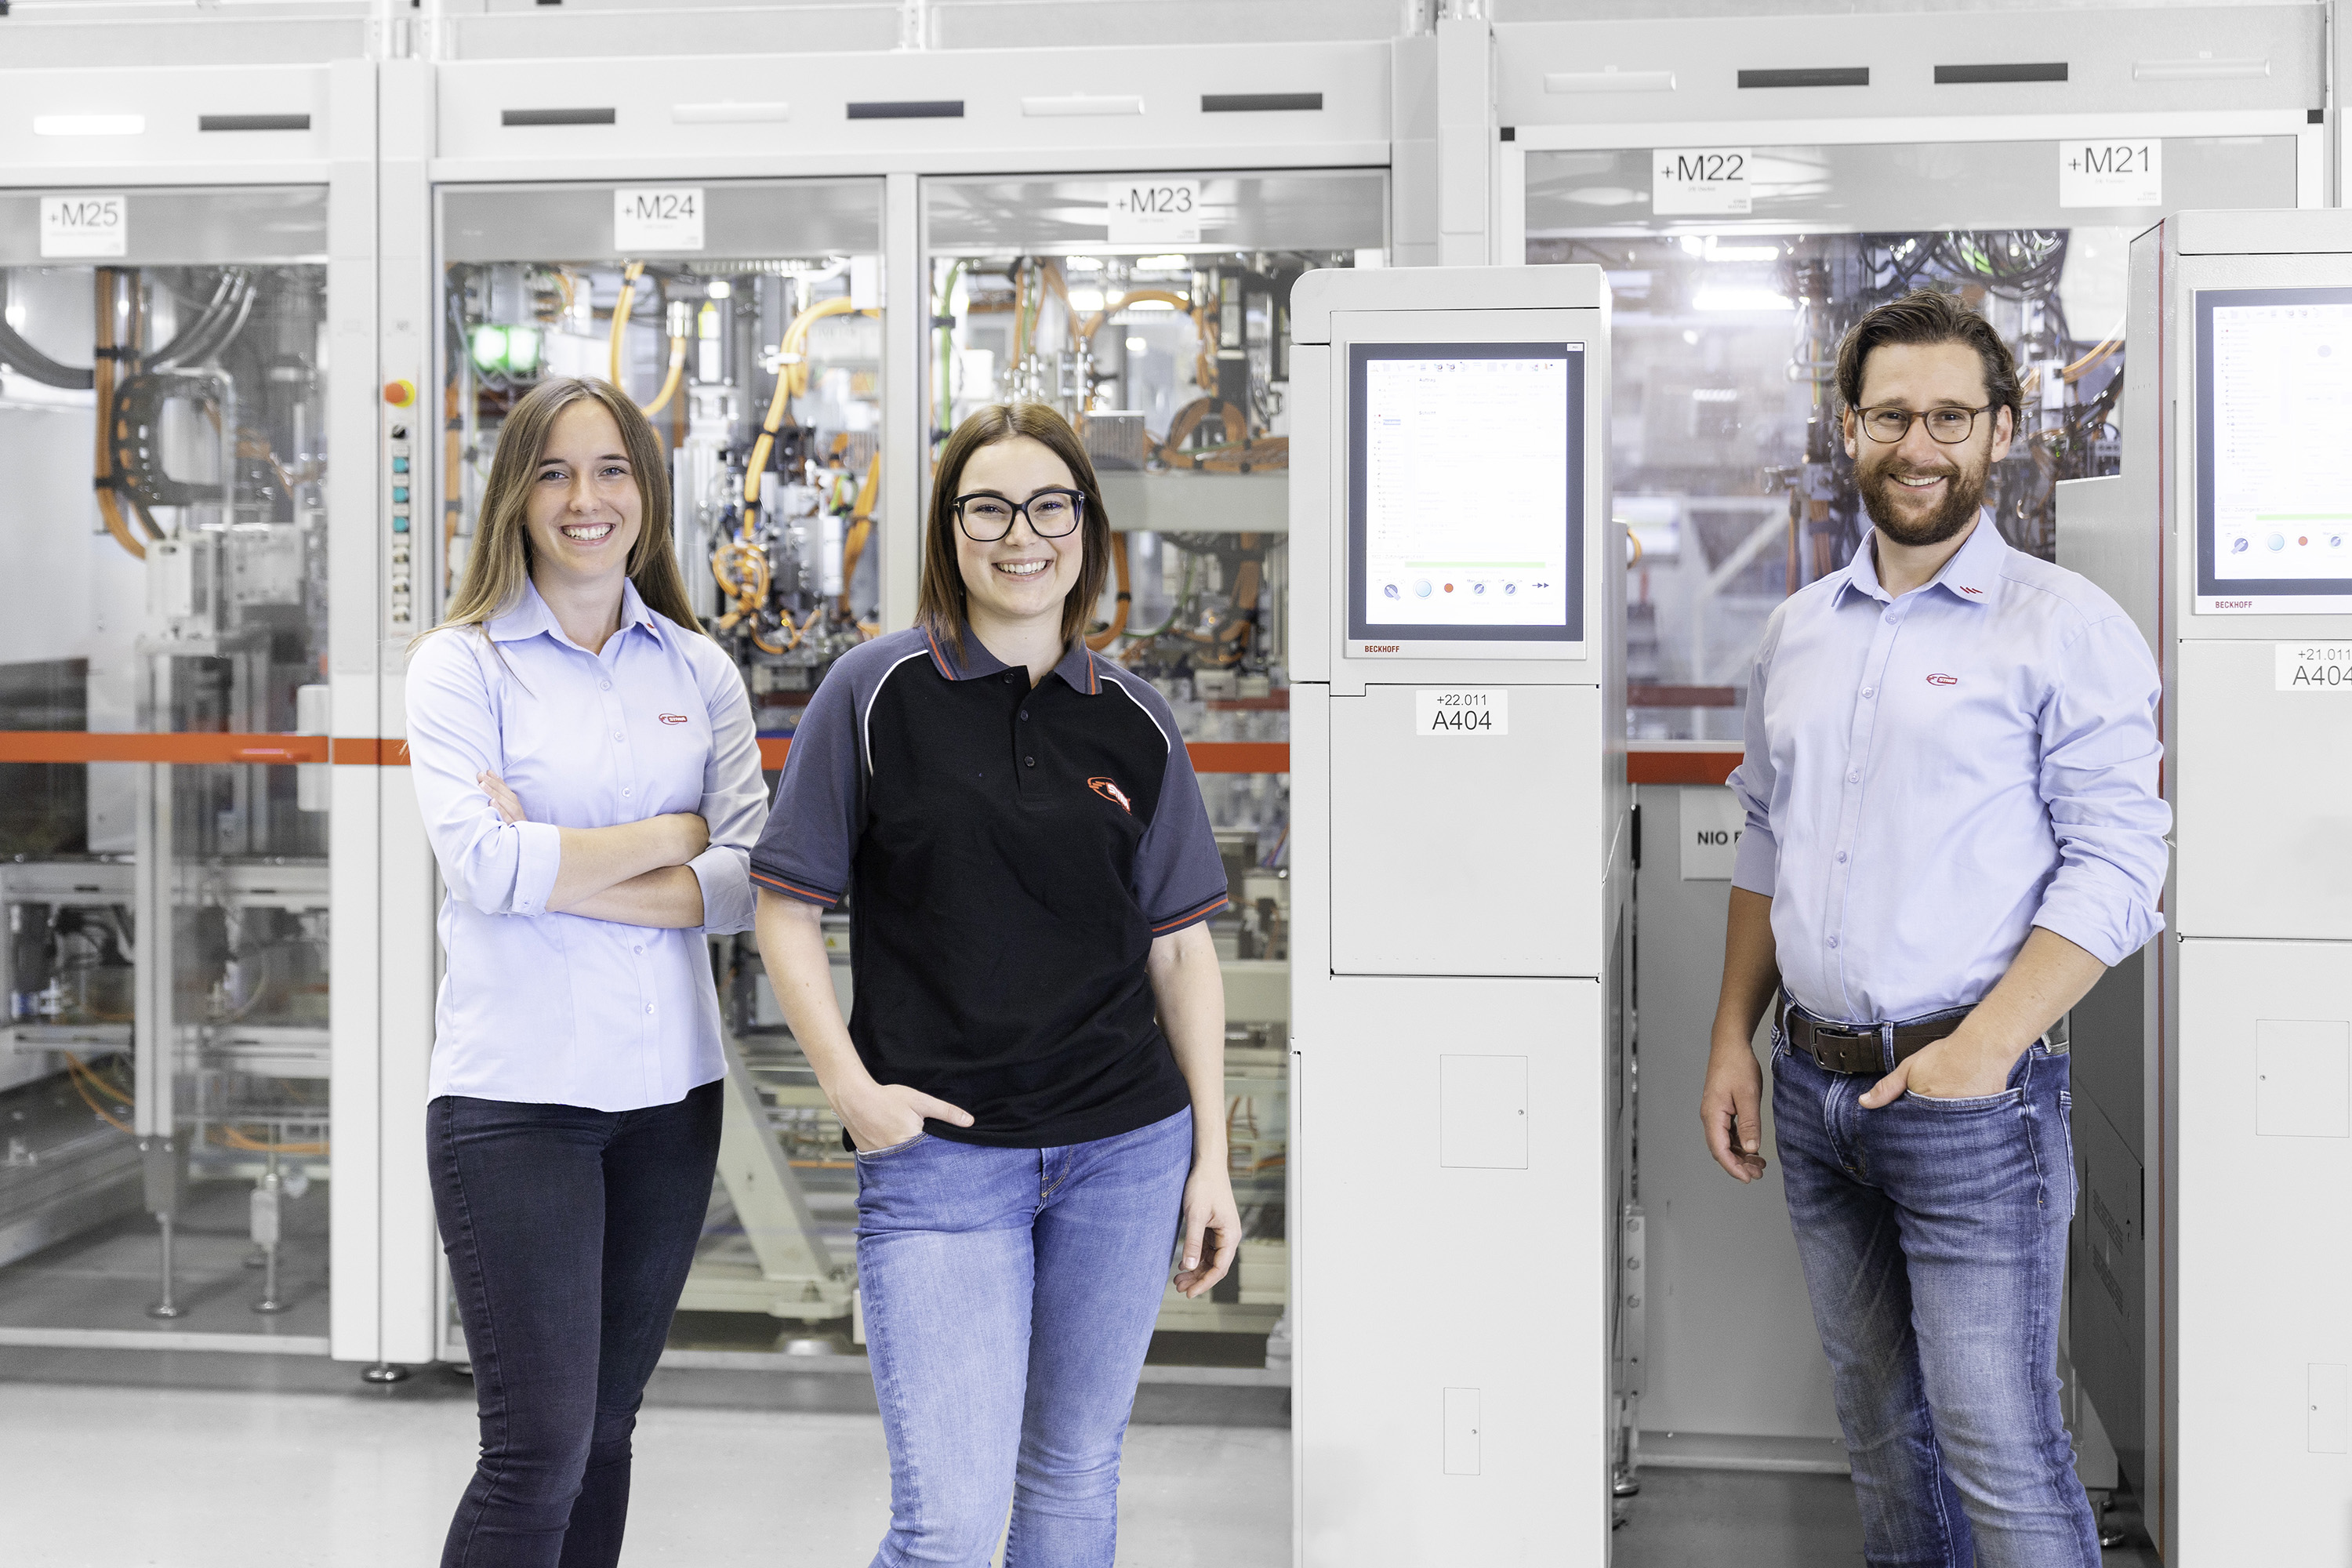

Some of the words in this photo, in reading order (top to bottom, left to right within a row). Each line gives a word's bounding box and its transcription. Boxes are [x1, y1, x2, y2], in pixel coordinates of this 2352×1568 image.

[1661, 154, 1744, 181] +M22
[2067, 146, 2149, 173] +M21
[622, 194, 695, 220] +M24
[1116, 187, 1192, 212] +M23
[48, 201, 118, 227] +M25
[2298, 648, 2351, 660] +21.011
[2292, 666, 2352, 685] A404
[1437, 694, 1486, 706] +22.011
[1432, 710, 1492, 730] A404
[1697, 831, 1728, 845] NIO
